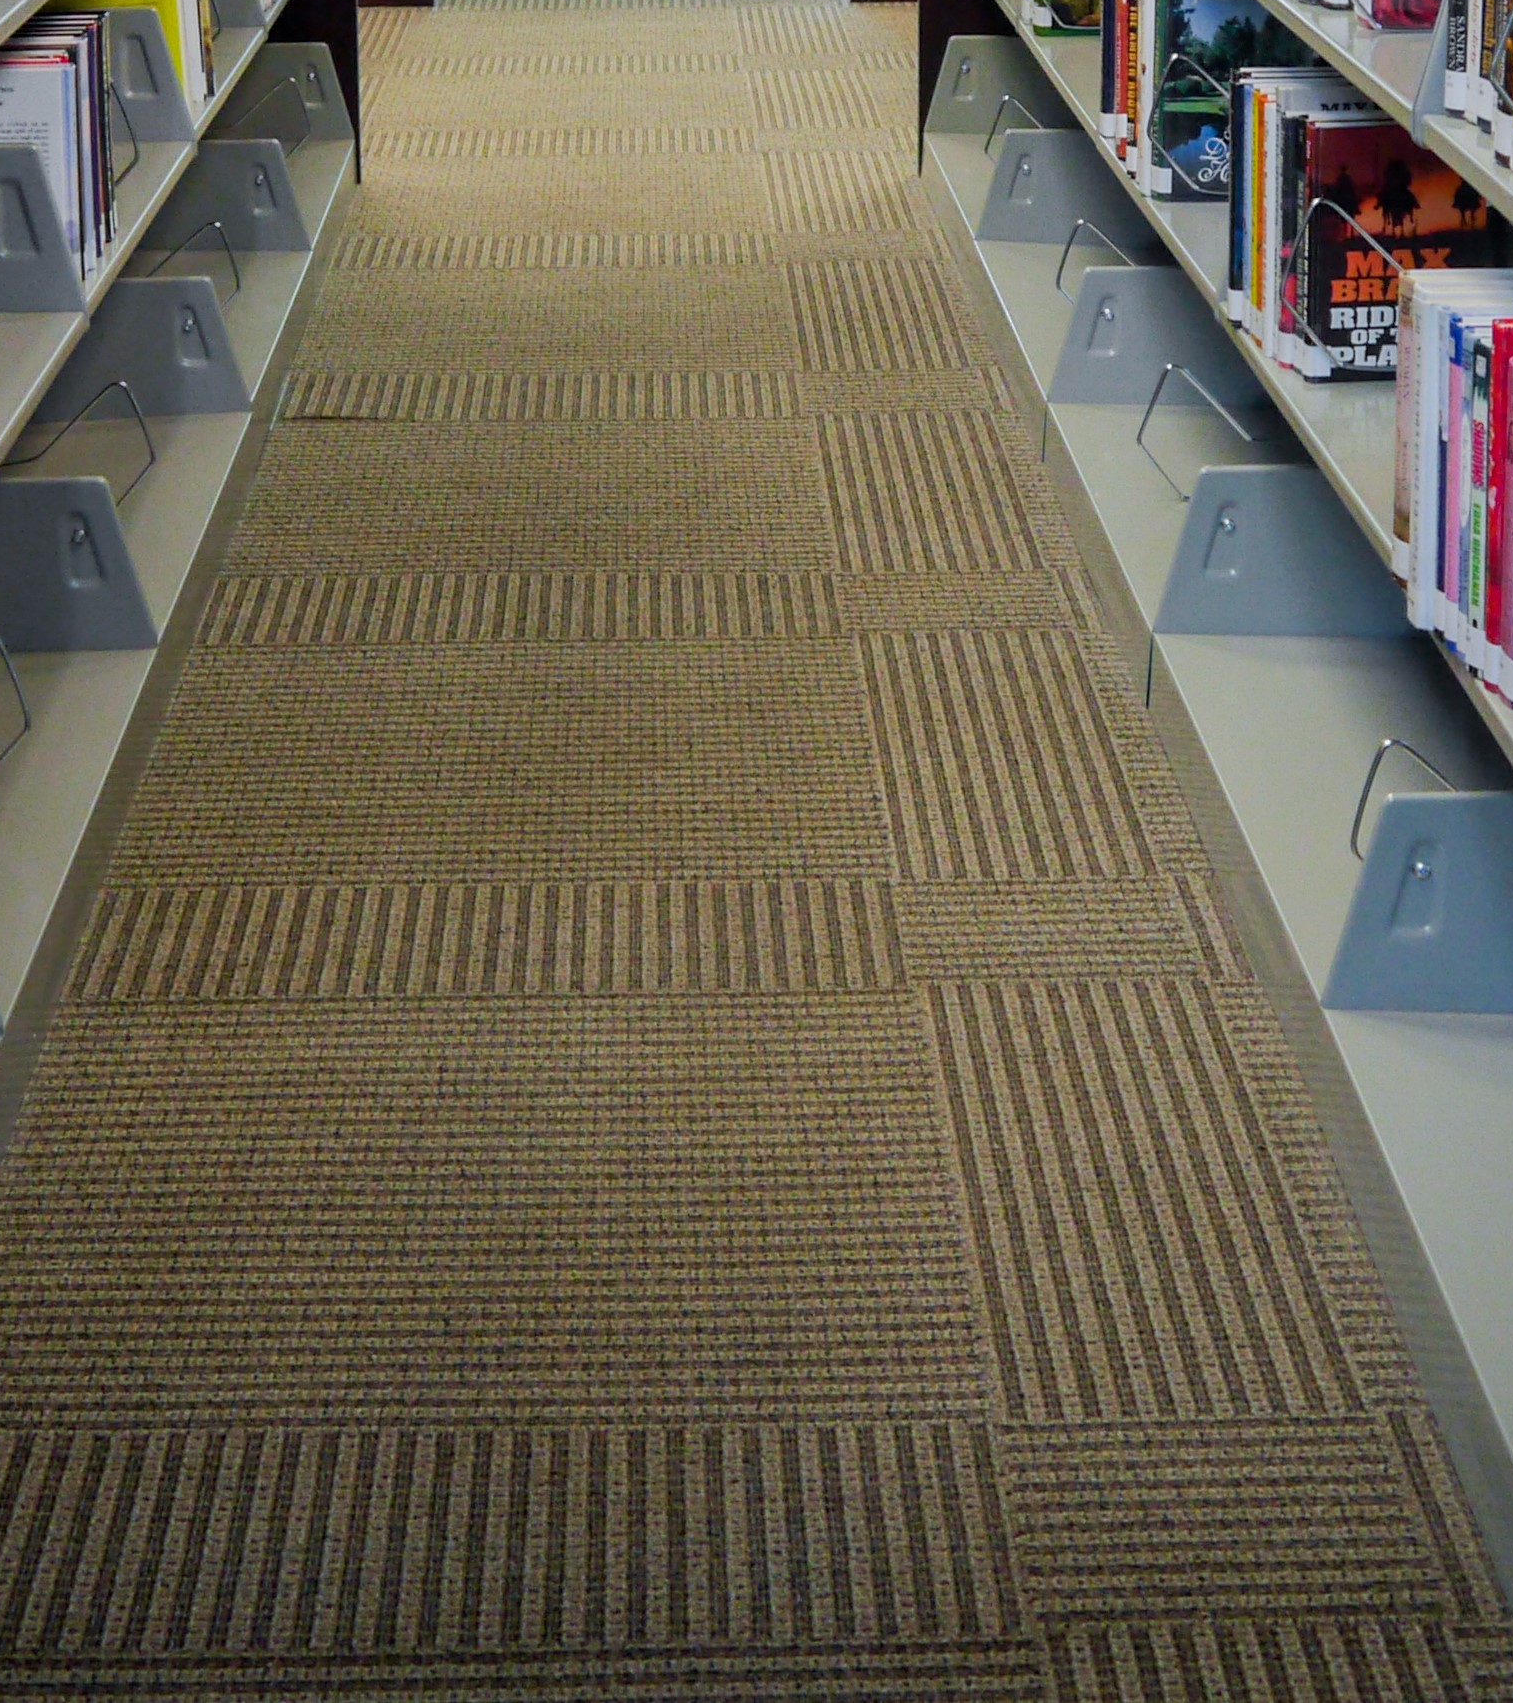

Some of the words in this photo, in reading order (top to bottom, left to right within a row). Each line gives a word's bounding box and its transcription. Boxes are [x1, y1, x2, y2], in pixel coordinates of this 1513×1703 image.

[1127, 32, 1139, 80] AMBER
[1447, 15, 1457, 70] BROWN
[1455, 15, 1467, 72] SANDRA
[1346, 248, 1452, 278] MAX
[1350, 329, 1385, 345] OF
[1472, 419, 1486, 487] SHADOWS
[1471, 502, 1482, 535] EDNA
[1471, 538, 1482, 607] BUCHANAN
